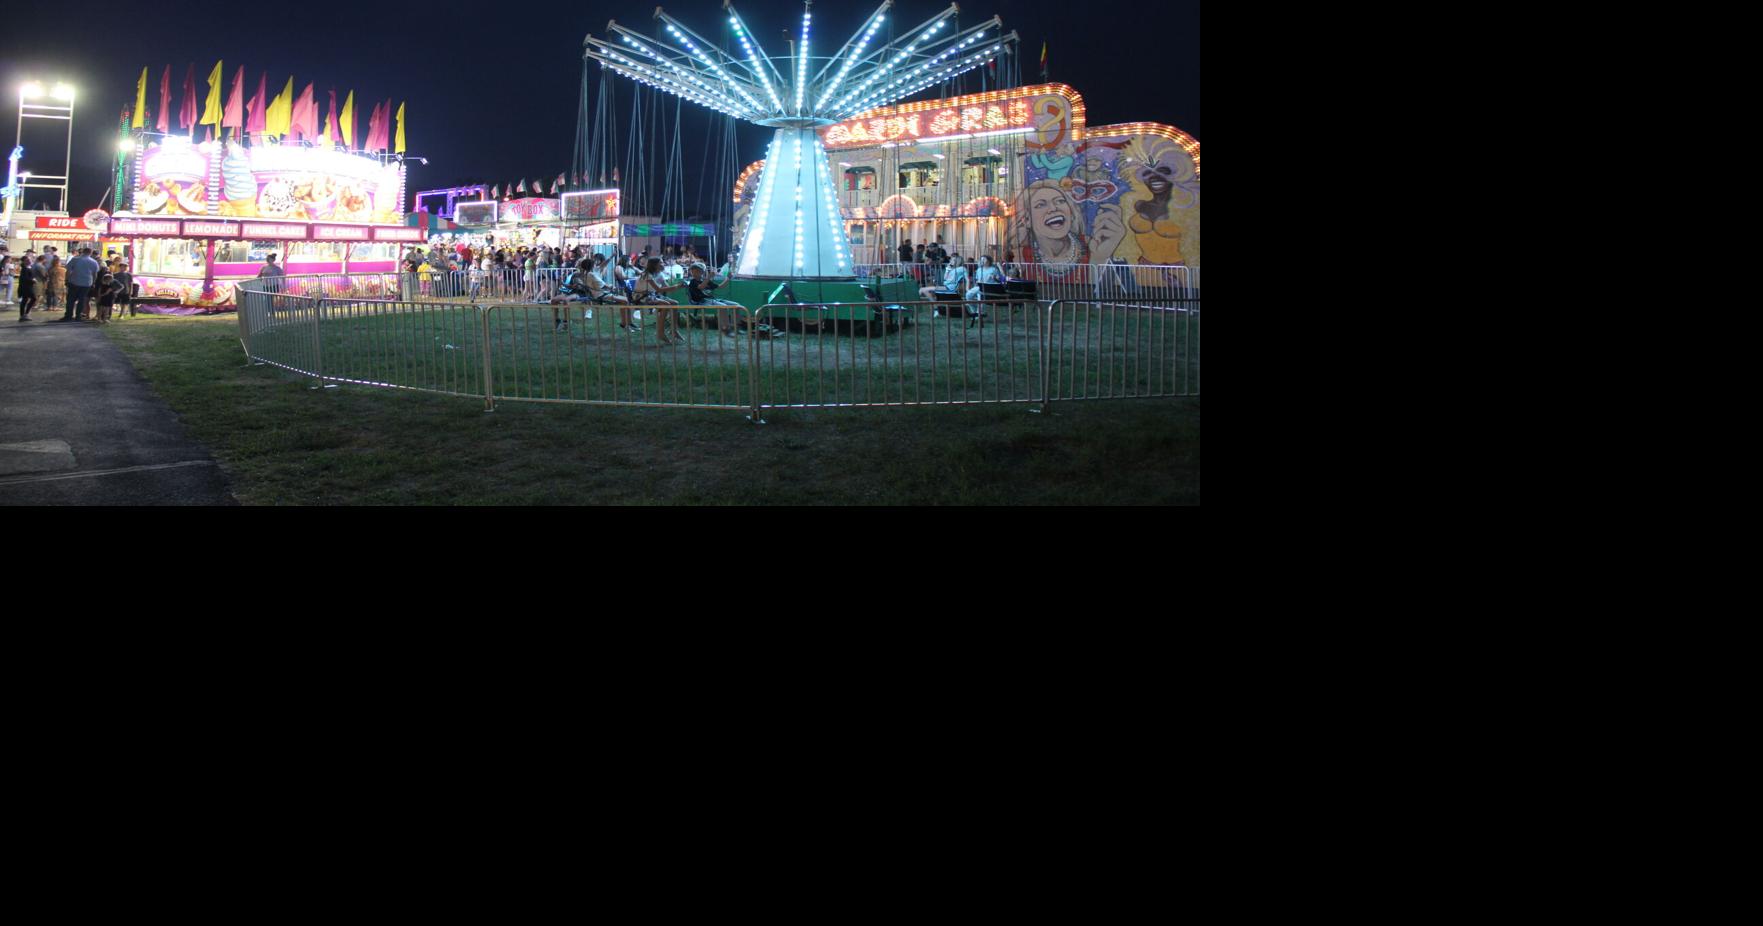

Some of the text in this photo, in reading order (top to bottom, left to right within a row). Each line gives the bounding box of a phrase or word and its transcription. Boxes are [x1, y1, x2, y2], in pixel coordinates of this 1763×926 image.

[930, 102, 1028, 134] GRAS
[511, 204, 544, 215] TOY BOX
[48, 219, 78, 227] RIDE
[138, 222, 177, 233] DONUTS
[185, 223, 238, 234] LEMONADE
[244, 225, 277, 235] FUNNEL
